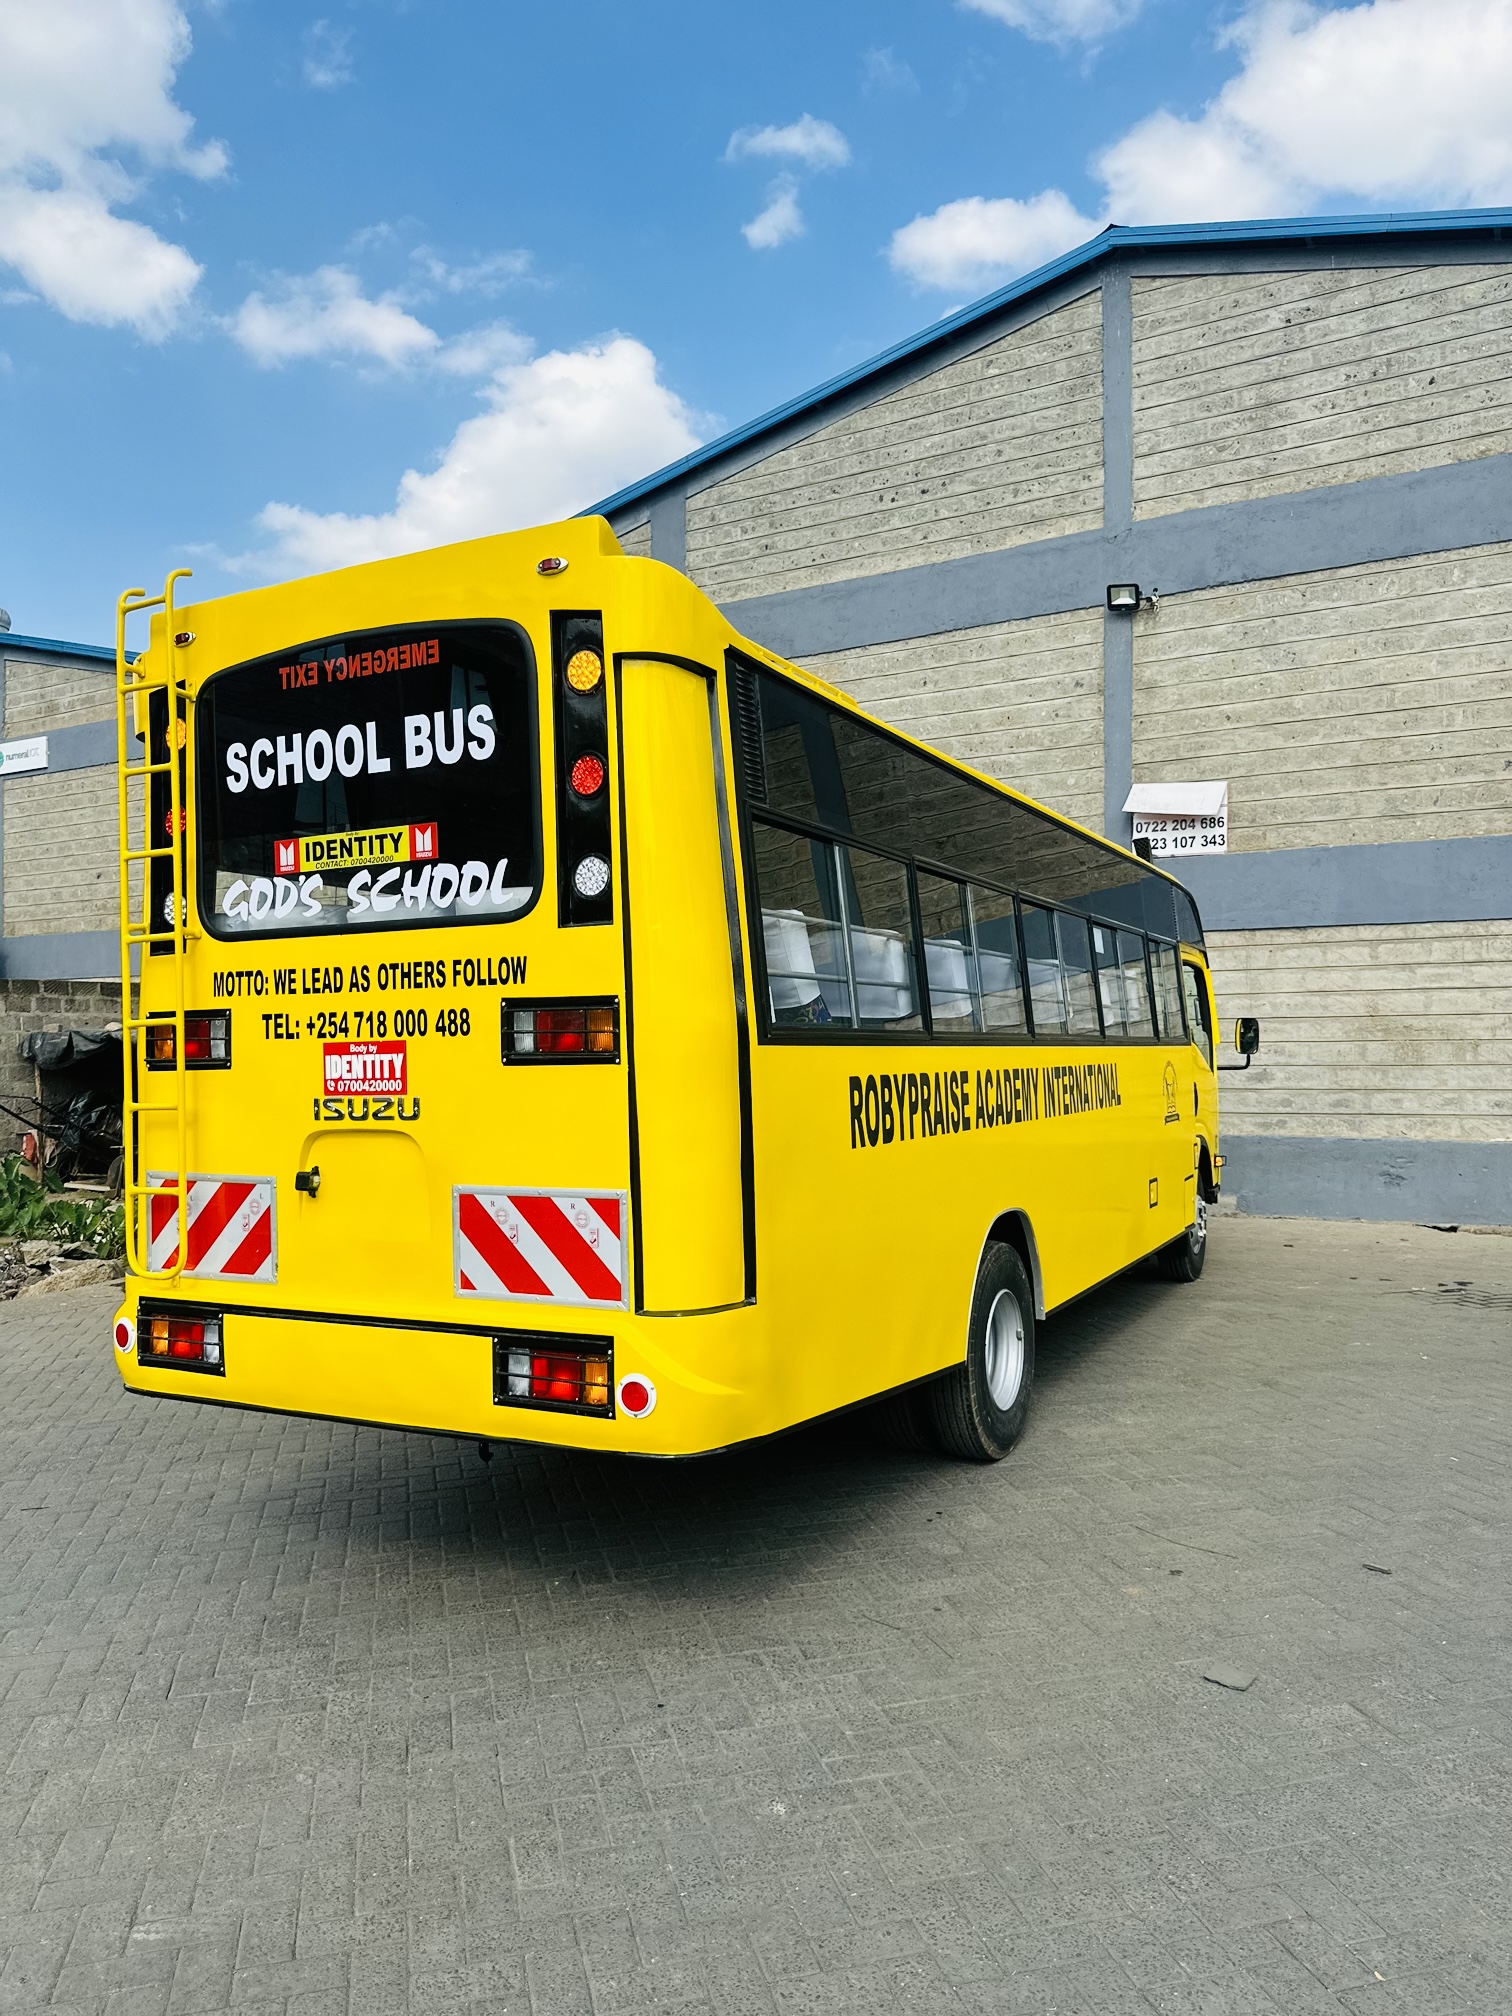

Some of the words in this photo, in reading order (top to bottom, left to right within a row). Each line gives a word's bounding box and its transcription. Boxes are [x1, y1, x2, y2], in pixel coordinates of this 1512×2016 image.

[226, 721, 391, 794] SCHOOL
[404, 704, 496, 770] BUS
[1135, 820, 1167, 834] 0722
[1171, 818, 1196, 831] 204
[1200, 816, 1225, 829] 686
[305, 832, 404, 863] IDENTITY
[1151, 837, 1167, 850] 23
[1172, 836, 1196, 849] 107
[1200, 834, 1226, 847] 343
[315, 859, 349, 869] CONTACT:
[350, 855, 394, 866] 0700420000
[222, 873, 324, 922] GOD'S
[347, 858, 514, 915] SCHOOL
[213, 970, 269, 997] MOTTO:
[273, 969, 297, 995] WE
[302, 965, 343, 994] LEAD
[349, 965, 371, 993] AS
[378, 959, 447, 991] OTHERS
[452, 955, 528, 987] FOLLOW
[262, 1013, 300, 1040] TEL:
[353, 1010, 387, 1038] 718
[393, 1008, 428, 1037] 000
[435, 1007, 471, 1037] 488
[349, 1044, 367, 1054] Body
[368, 1044, 377, 1054] by
[325, 1053, 404, 1080] IDENTITY
[337, 1079, 403, 1092] 0700420000
[313, 1096, 421, 1121] ISUZU
[848, 1070, 971, 1149] ROBYPRAISE
[975, 1067, 1039, 1129] ACADEMY
[1042, 1062, 1122, 1119] INTERNATIONAL
